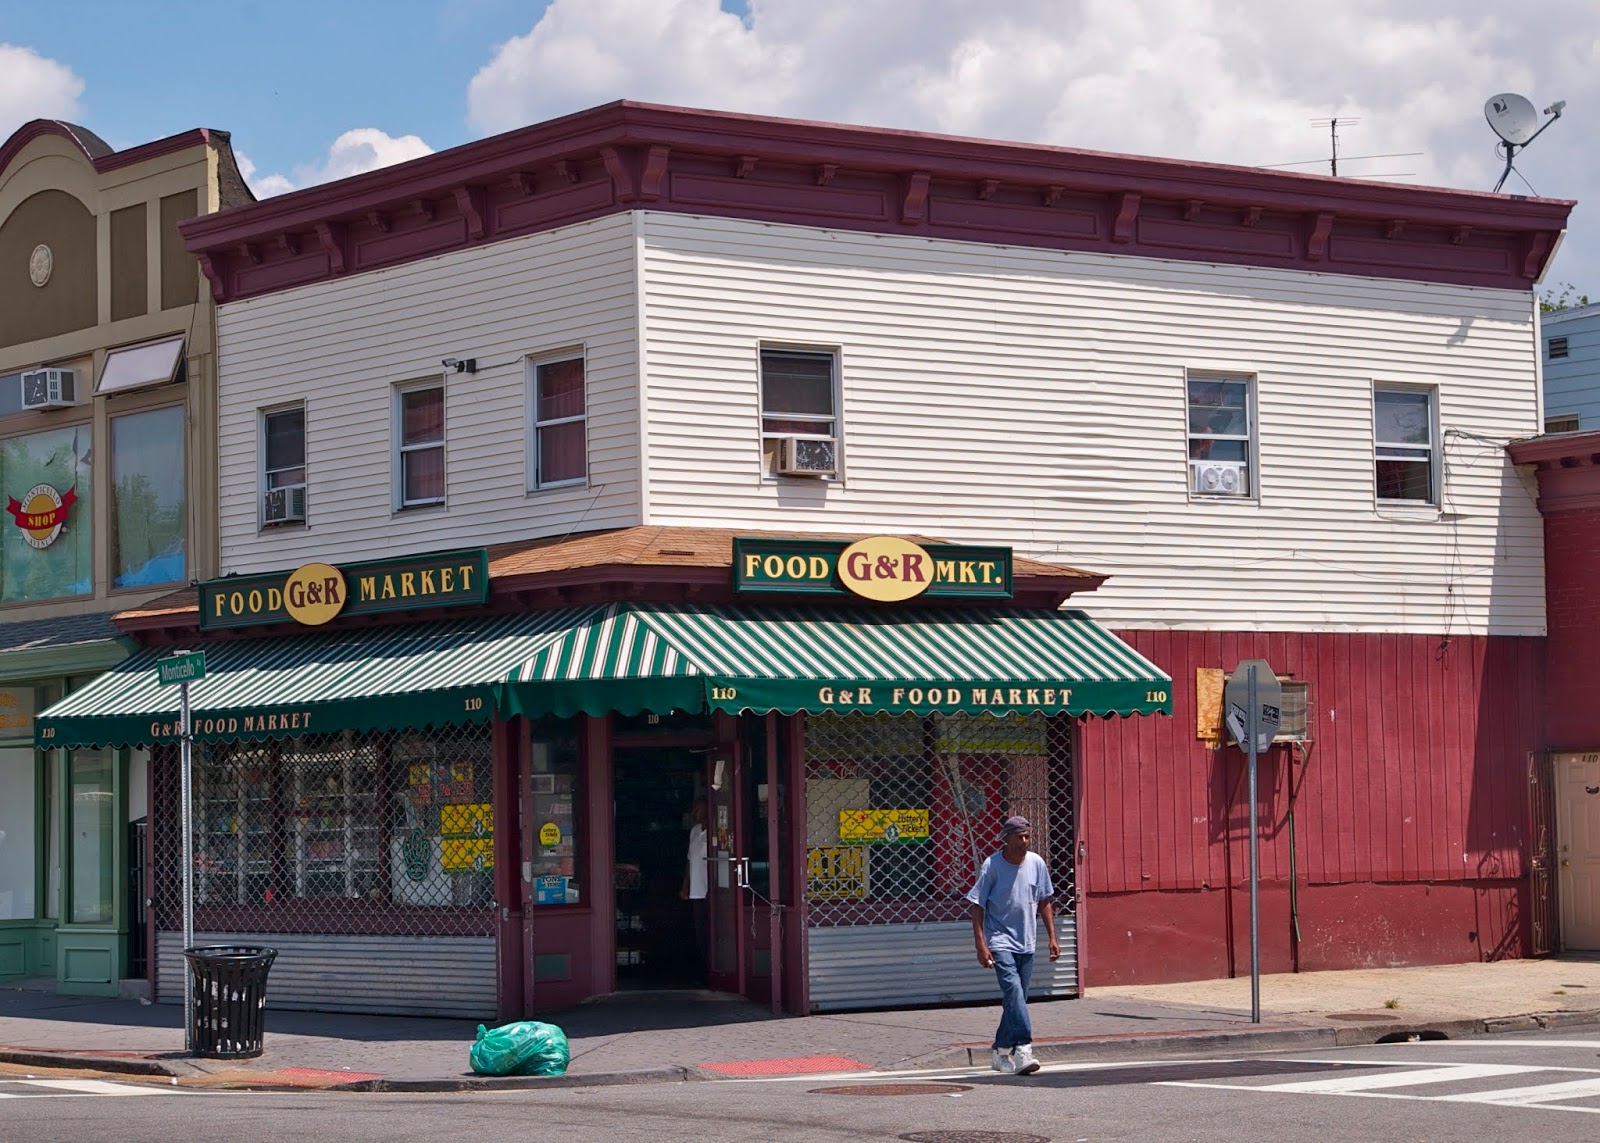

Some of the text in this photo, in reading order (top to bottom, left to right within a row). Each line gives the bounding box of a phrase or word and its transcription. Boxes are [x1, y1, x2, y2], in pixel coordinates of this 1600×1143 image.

[23, 485, 61, 508] MONTICELLO
[27, 512, 56, 527] SHOP
[745, 551, 1002, 584] FOOD G&R MKT.
[215, 565, 474, 617] FOOD G&R MARKET
[161, 658, 195, 682] Monticello
[711, 687, 737, 700] 110
[818, 686, 1073, 706] G&R FOOD MARKET
[1146, 691, 1167, 703] 110
[464, 698, 482, 711] 110
[194, 715, 238, 735] FOOD
[243, 712, 312, 732] MARKET
[647, 714, 660, 725] 110
[42, 727, 56, 739] 110
[897, 815, 924, 827] Lottery
[902, 824, 926, 833] Tickets
